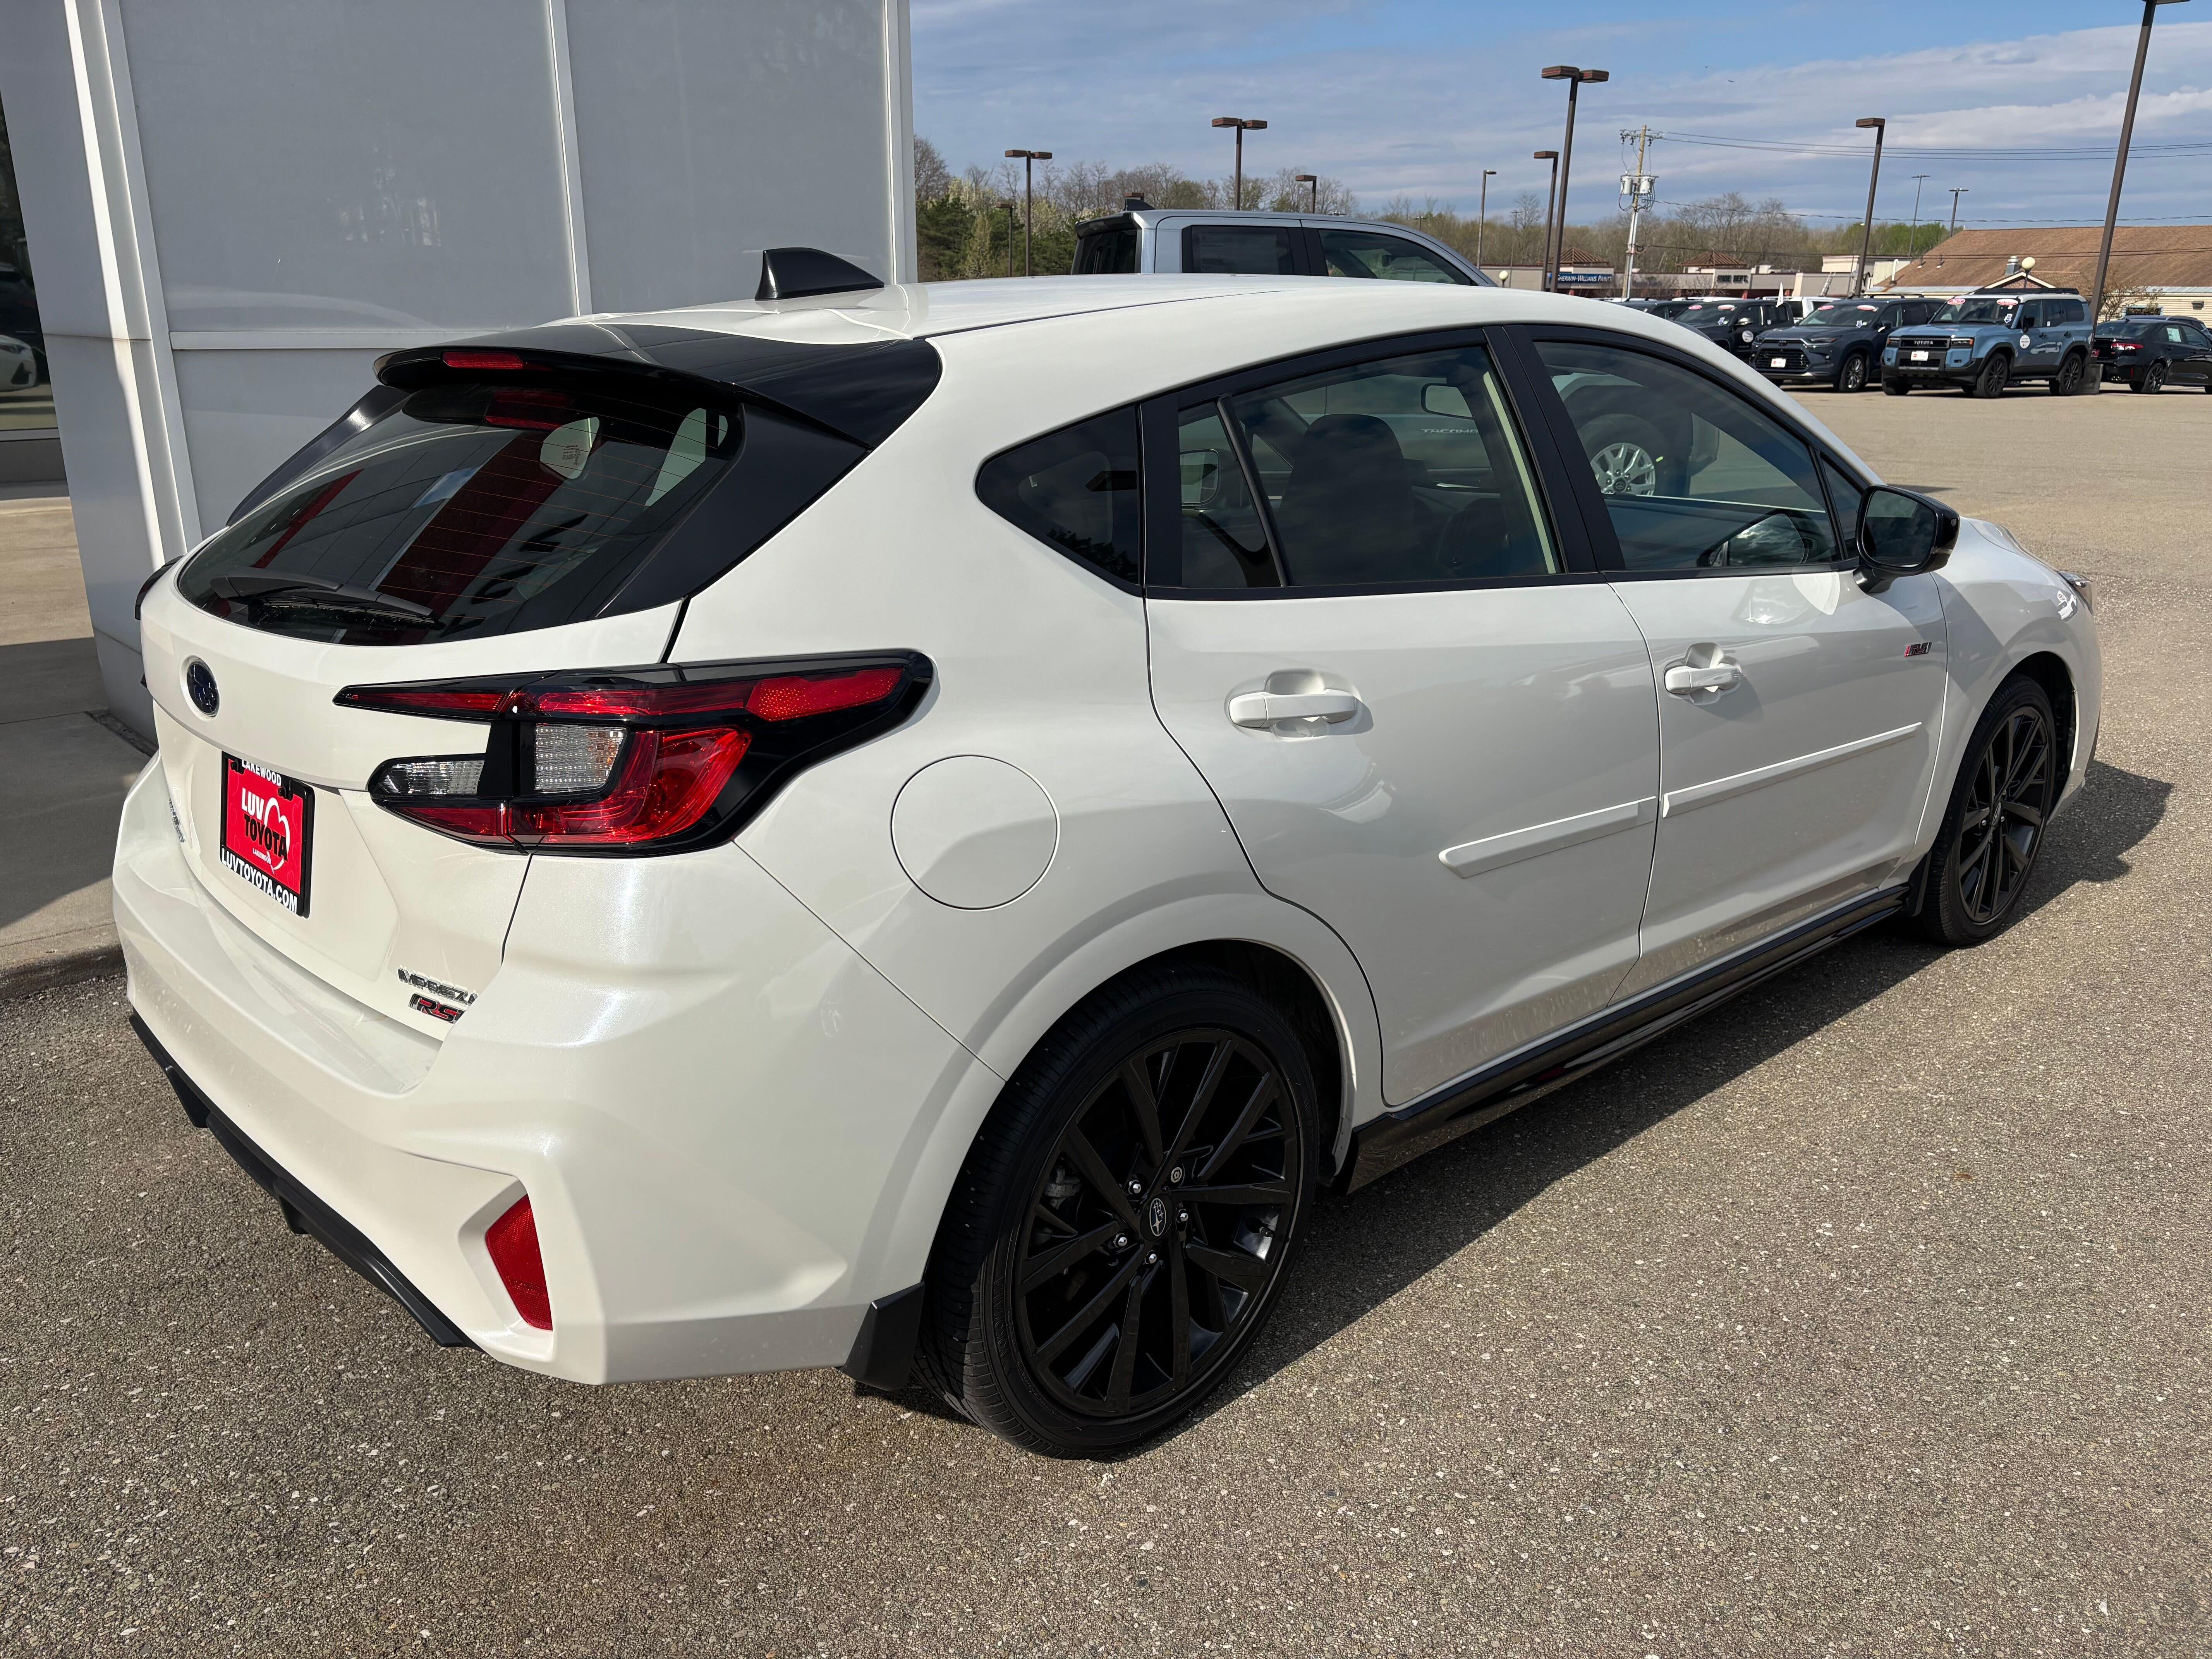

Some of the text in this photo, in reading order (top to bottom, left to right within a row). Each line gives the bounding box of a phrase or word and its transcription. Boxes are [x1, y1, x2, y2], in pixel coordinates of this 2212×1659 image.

[242, 759, 282, 787] LAKEWOOD
[241, 787, 264, 821] LUV
[244, 813, 288, 862] TOYOTA
[252, 847, 271, 865] LAKEWOOD
[222, 848, 298, 914] LUVTOYOTA.COM
